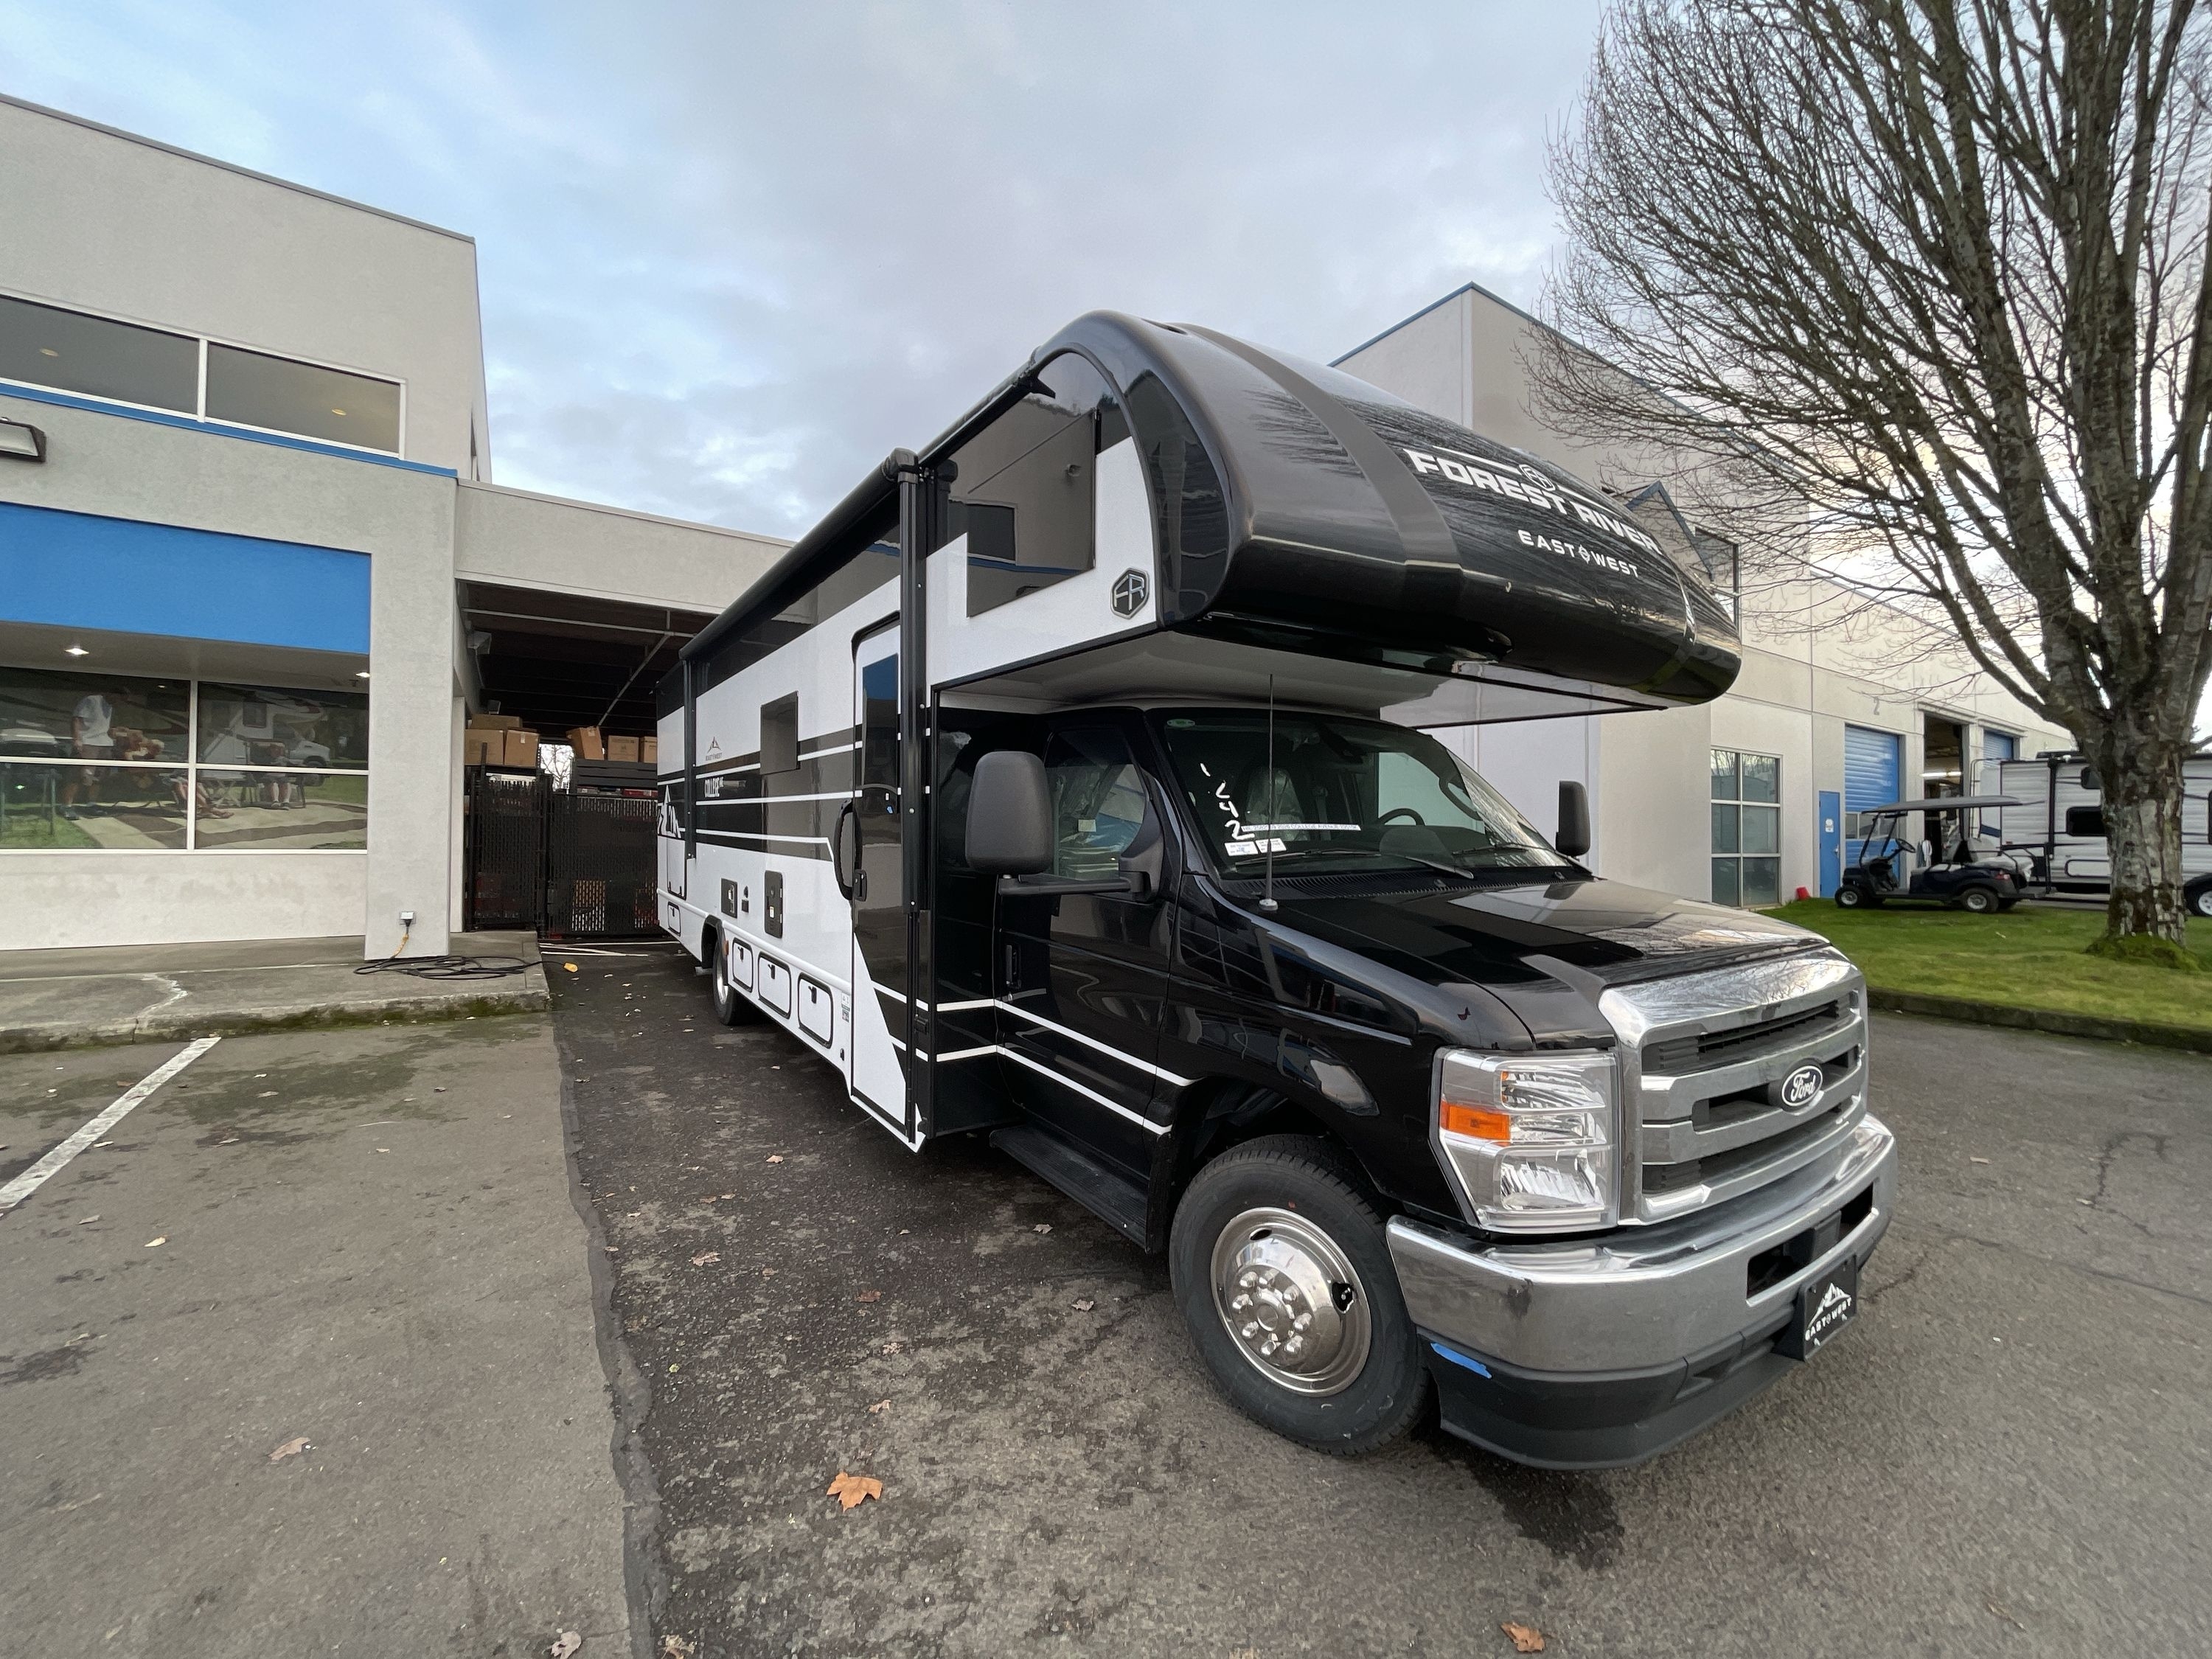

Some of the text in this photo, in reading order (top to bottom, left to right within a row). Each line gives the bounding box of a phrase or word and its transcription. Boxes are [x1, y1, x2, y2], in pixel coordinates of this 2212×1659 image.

[1402, 448, 1663, 554] FOREST RIVER
[1517, 529, 1638, 578] EAST WEST
[1874, 696, 1880, 715] 2
[1790, 1071, 1816, 1102] Ford
